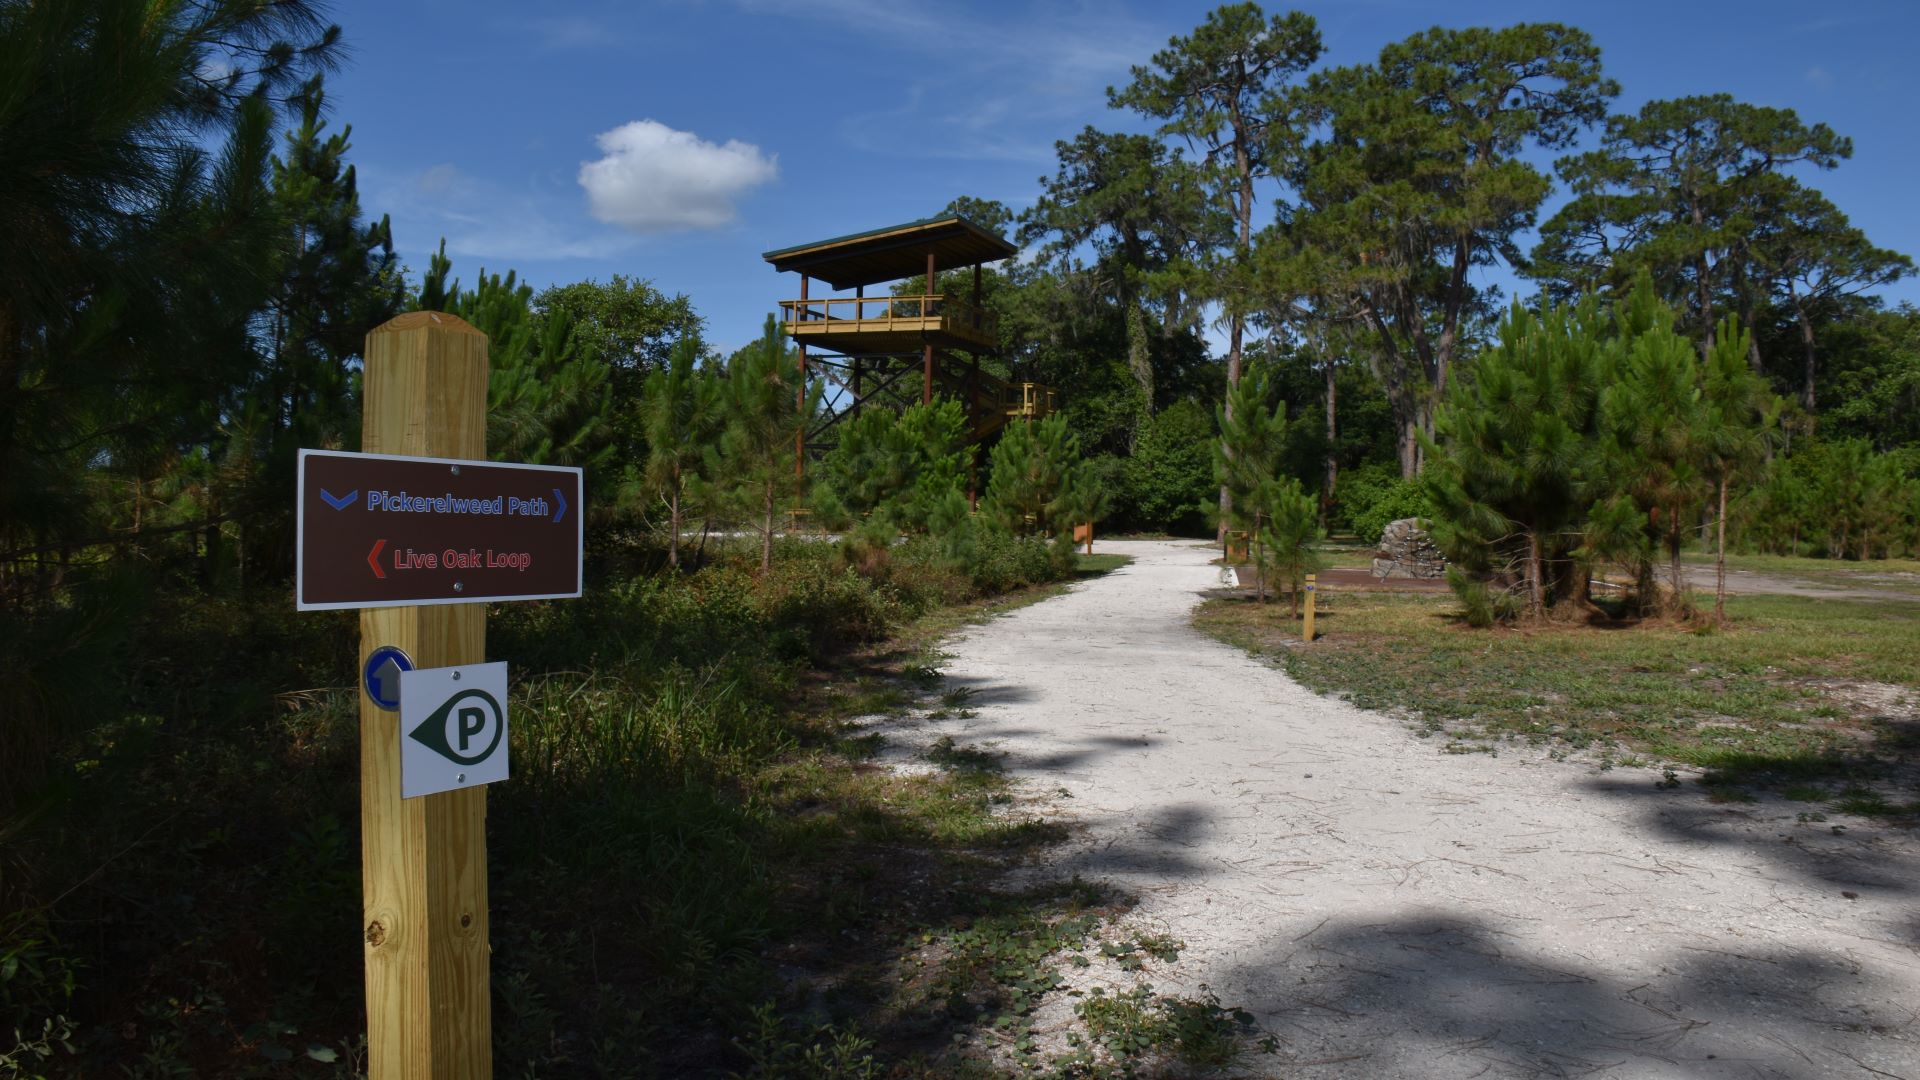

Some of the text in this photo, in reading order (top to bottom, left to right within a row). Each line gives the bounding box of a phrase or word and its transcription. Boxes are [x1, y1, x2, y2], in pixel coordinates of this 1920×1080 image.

[367, 491, 549, 516] Pickerelweed Path
[394, 549, 531, 571] Live Oak Loop
[458, 707, 486, 751] P
